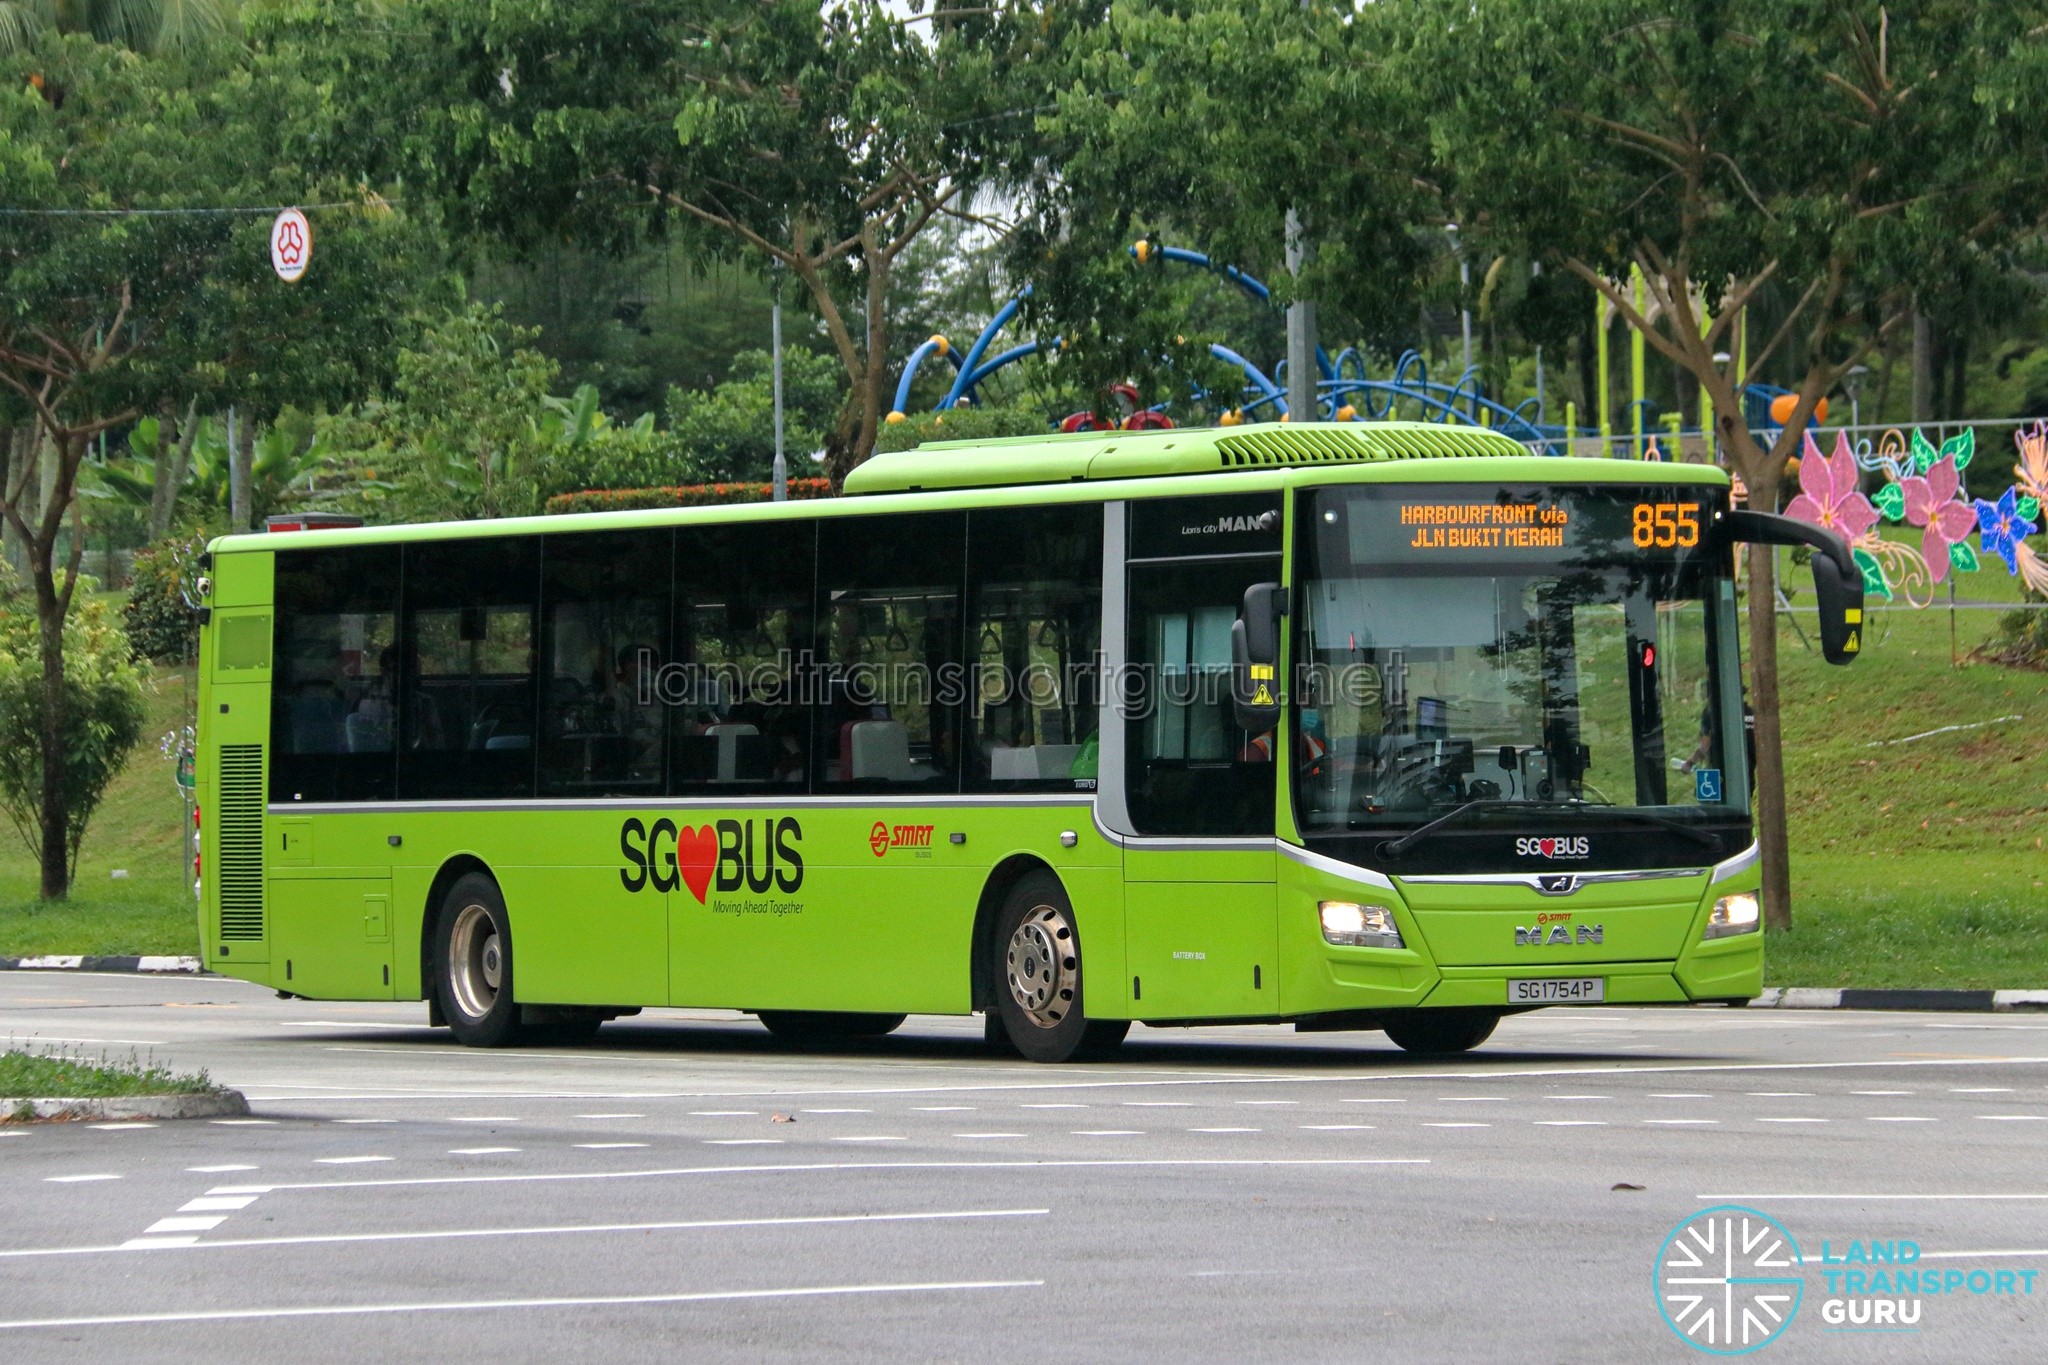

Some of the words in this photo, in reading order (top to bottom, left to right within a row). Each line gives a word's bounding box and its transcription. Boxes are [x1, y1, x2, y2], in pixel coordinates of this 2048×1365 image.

[1401, 505, 1537, 524] HARBOURFRONT
[1540, 505, 1568, 524] via
[1202, 524, 1218, 534] City
[1218, 515, 1261, 533] MAN
[1632, 503, 1700, 548] 855
[1411, 528, 1445, 548] JLN
[1449, 528, 1501, 547] BUKIT
[1505, 527, 1563, 547] MERAH
[890, 825, 934, 846] SMRT
[713, 900, 742, 917] Moving
[743, 900, 768, 914] Ahead
[769, 899, 804, 917] Together
[1549, 913, 1572, 921] SMRT
[1515, 924, 1603, 946] MAN
[1173, 951, 1194, 959] BATTERY
[1195, 952, 1206, 960] BOX
[1518, 981, 1594, 999] SG1754P
